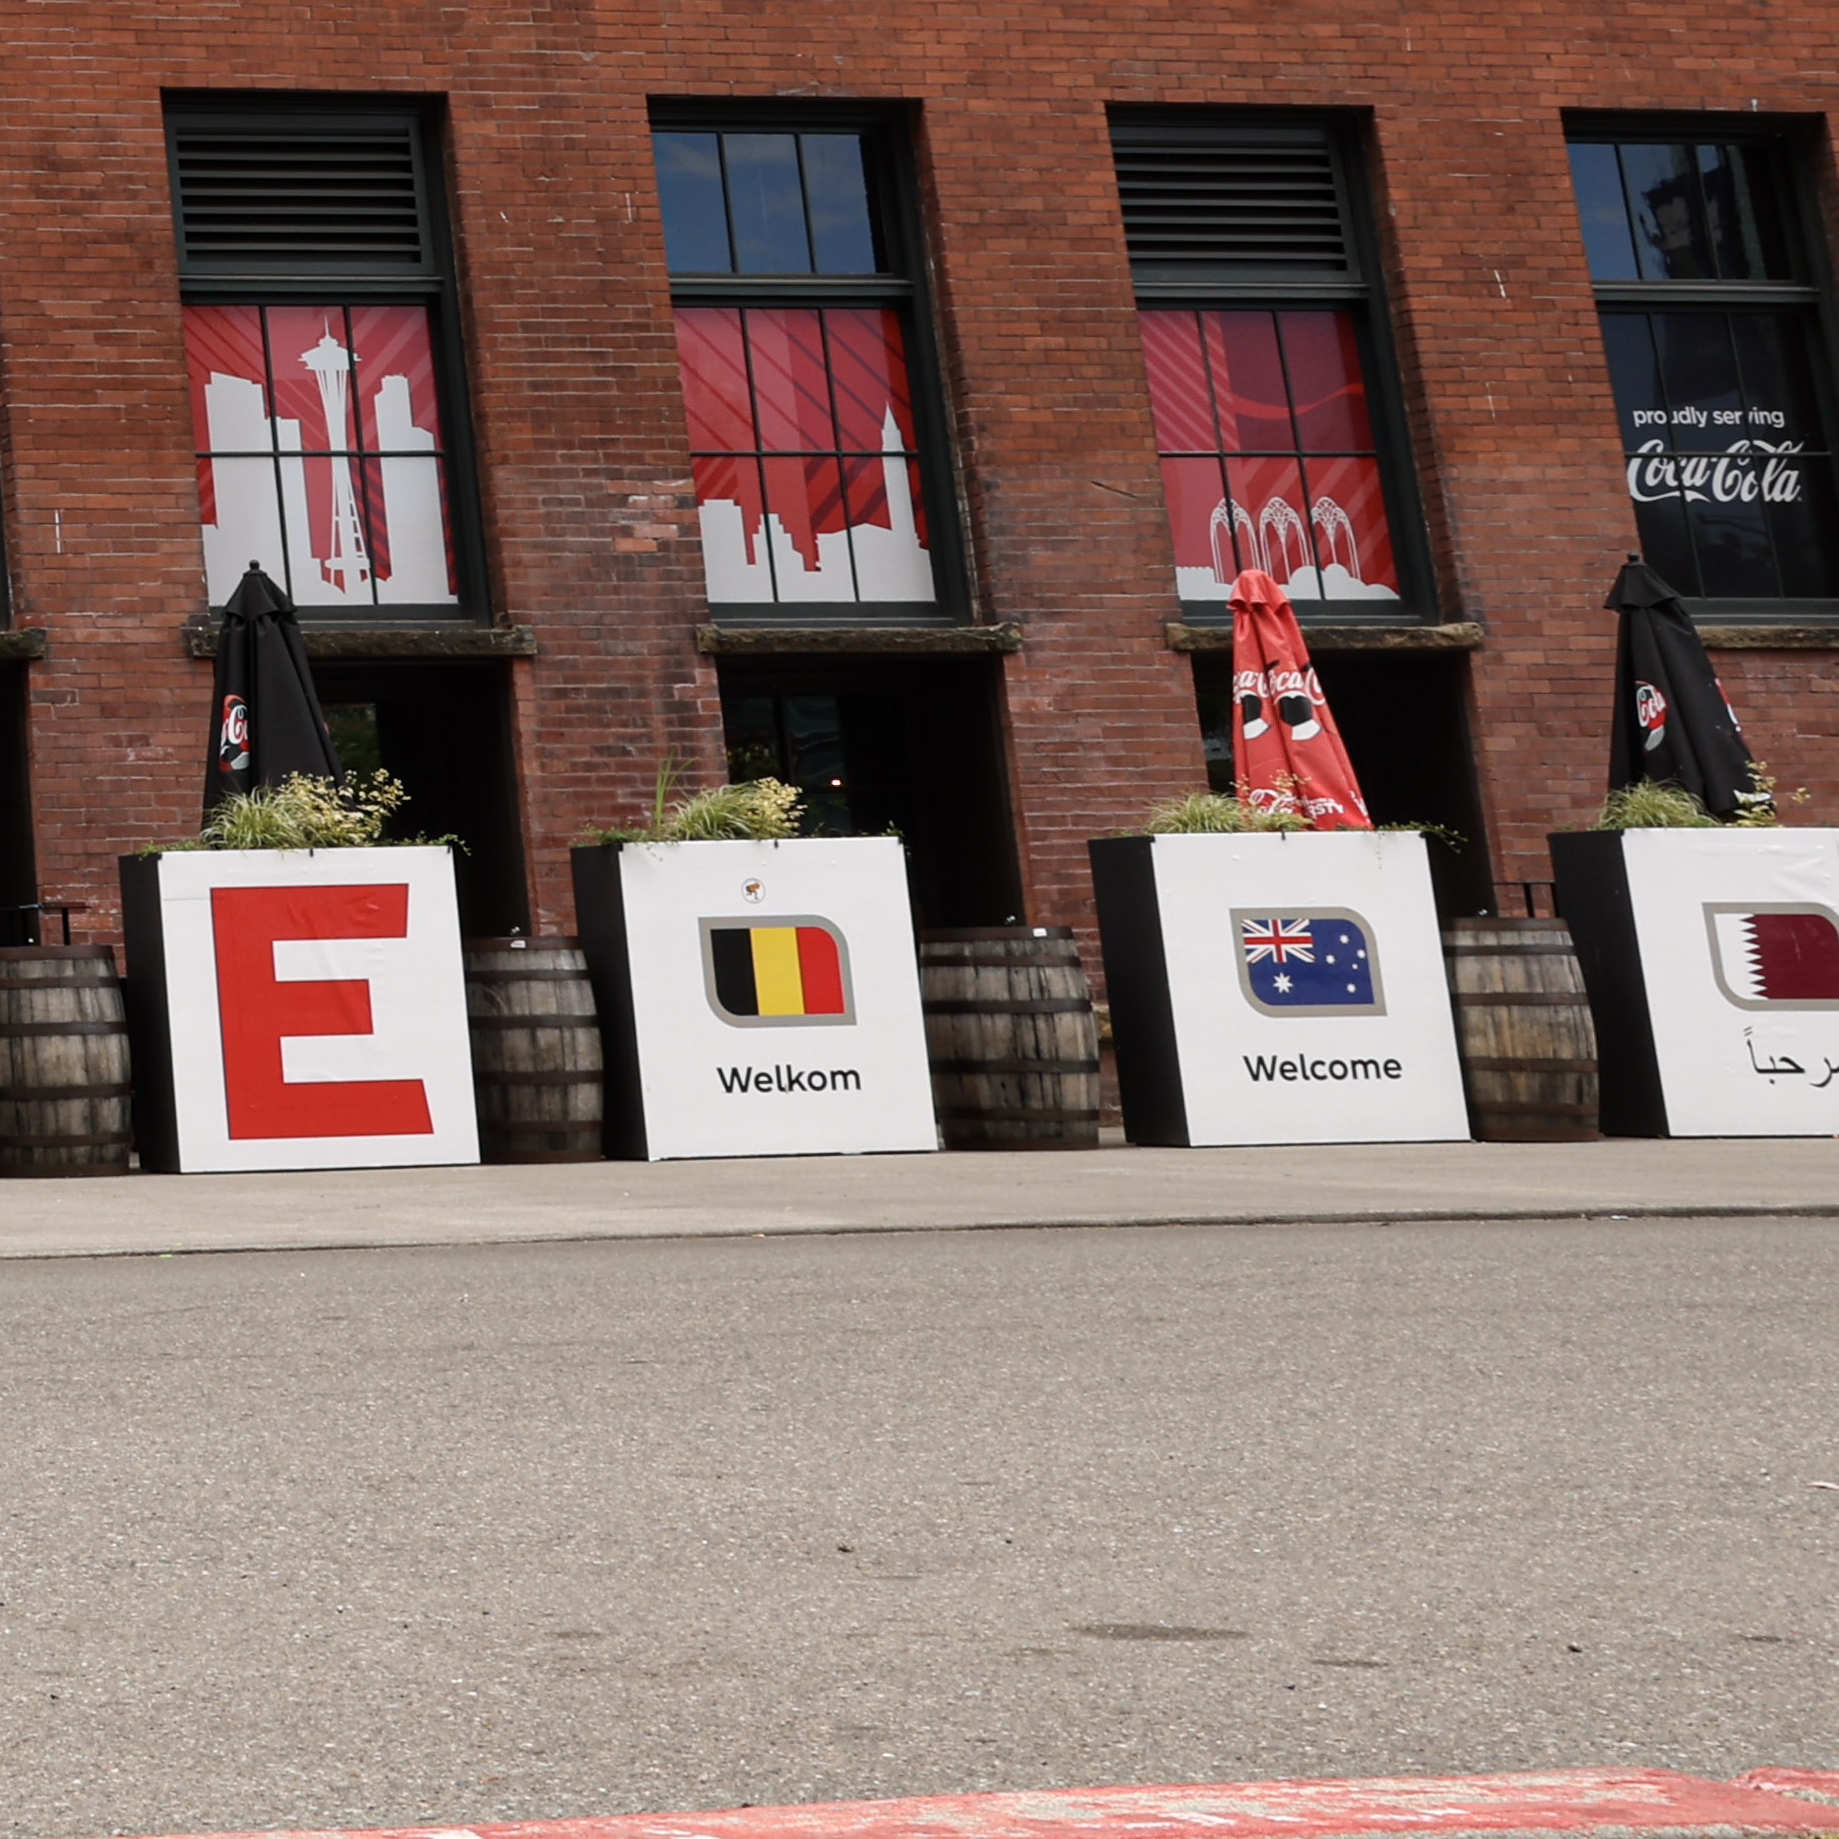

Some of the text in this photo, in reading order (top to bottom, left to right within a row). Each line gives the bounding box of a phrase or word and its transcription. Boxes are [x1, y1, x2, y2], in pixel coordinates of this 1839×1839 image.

[1627, 439, 1805, 503] Coca-Cola
[717, 1064, 862, 1093] Welkom
[1242, 1053, 1403, 1082] Welcome
[1743, 1026, 1839, 1088] رحباً
